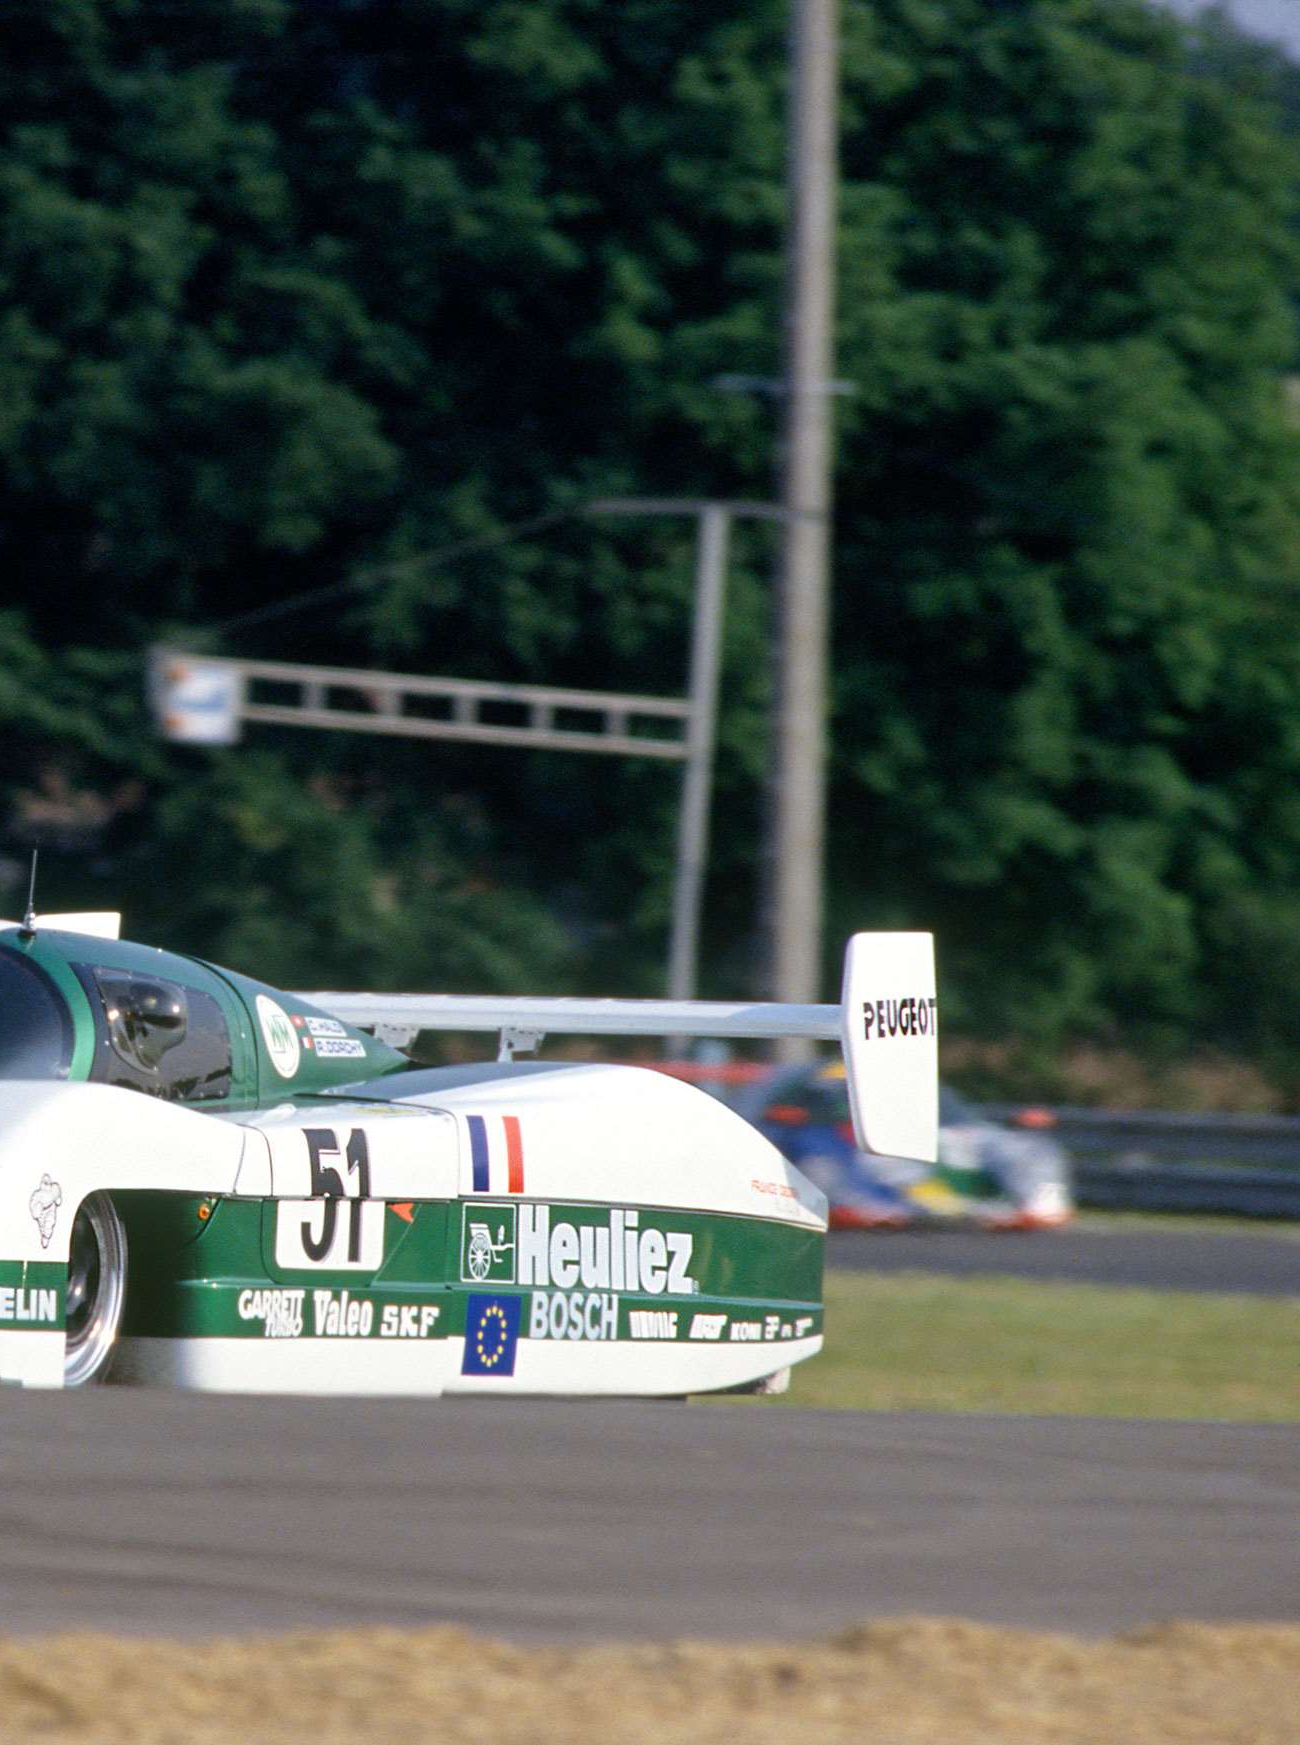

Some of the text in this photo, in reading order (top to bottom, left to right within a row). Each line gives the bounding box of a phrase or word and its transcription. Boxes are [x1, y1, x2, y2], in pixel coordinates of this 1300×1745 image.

[863, 998, 937, 1040] PEUGEOT
[301, 1128, 371, 1263] 51
[518, 1204, 693, 1295] Heuliez
[238, 1289, 306, 1322] GARRETT
[313, 1290, 373, 1337] Valeo
[380, 1305, 440, 1338] SKF
[529, 1291, 618, 1340] BOSCH
